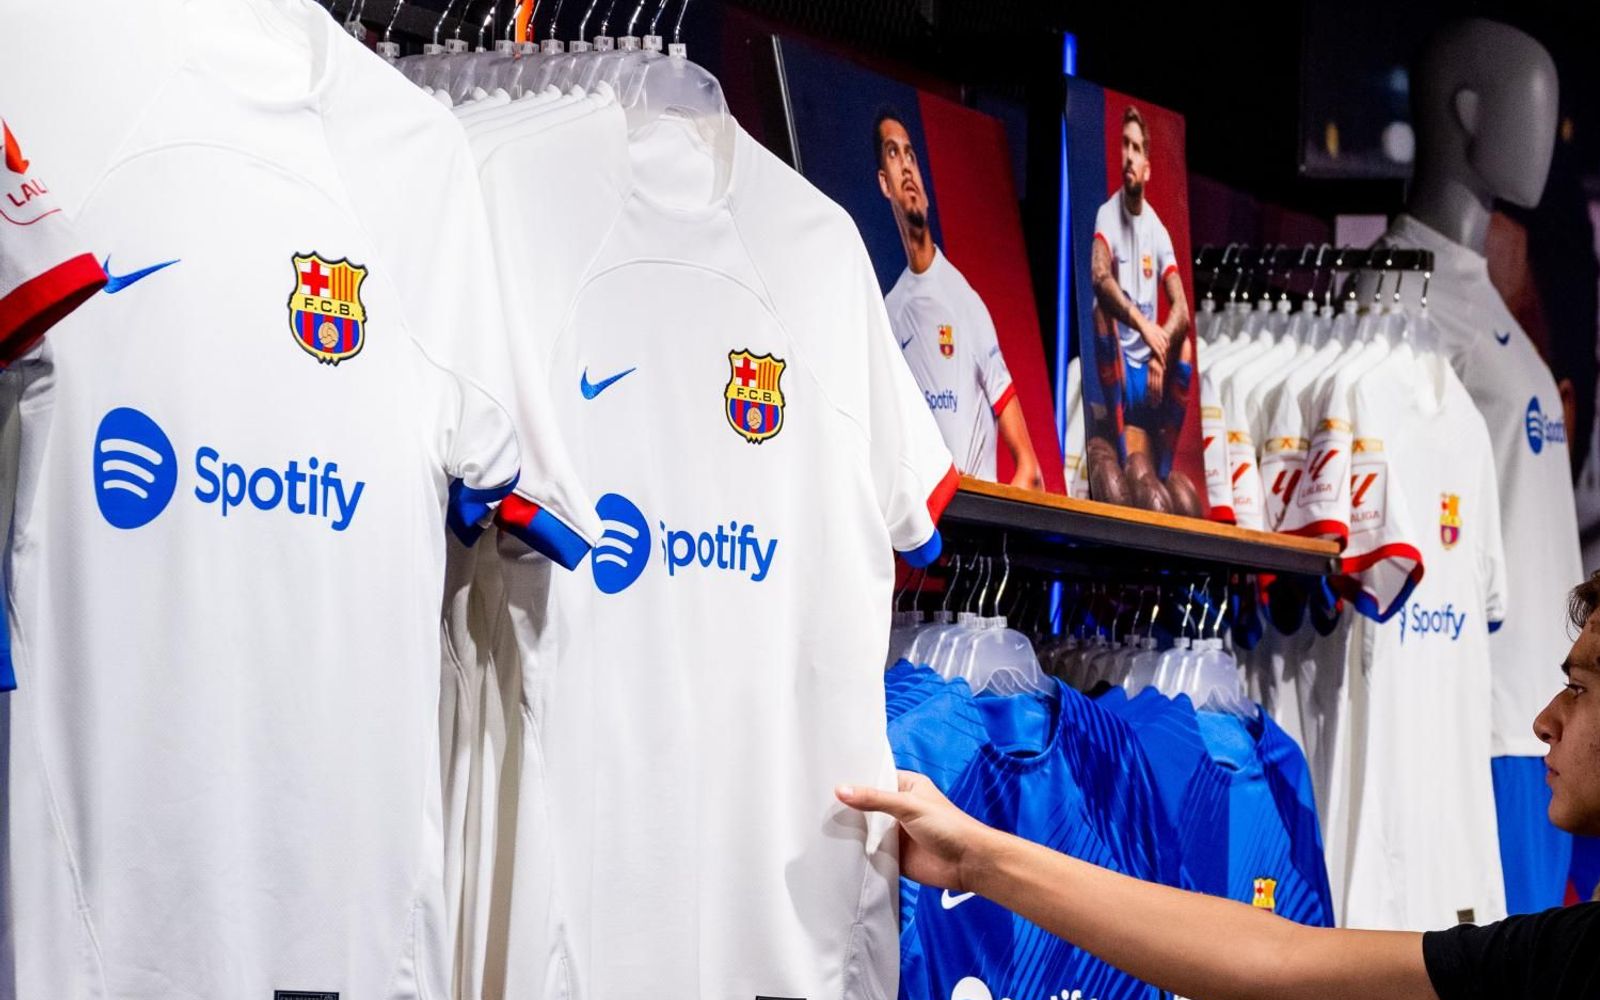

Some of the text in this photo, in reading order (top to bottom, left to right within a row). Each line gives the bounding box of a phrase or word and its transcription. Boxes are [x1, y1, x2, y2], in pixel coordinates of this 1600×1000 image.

[7, 178, 48, 208] LAL
[304, 297, 355, 317] F.C.B.
[736, 387, 776, 403] F.C.B.
[194, 446, 366, 532] Spotify
[1350, 510, 1380, 523] ALIGA
[659, 520, 778, 582] potify
